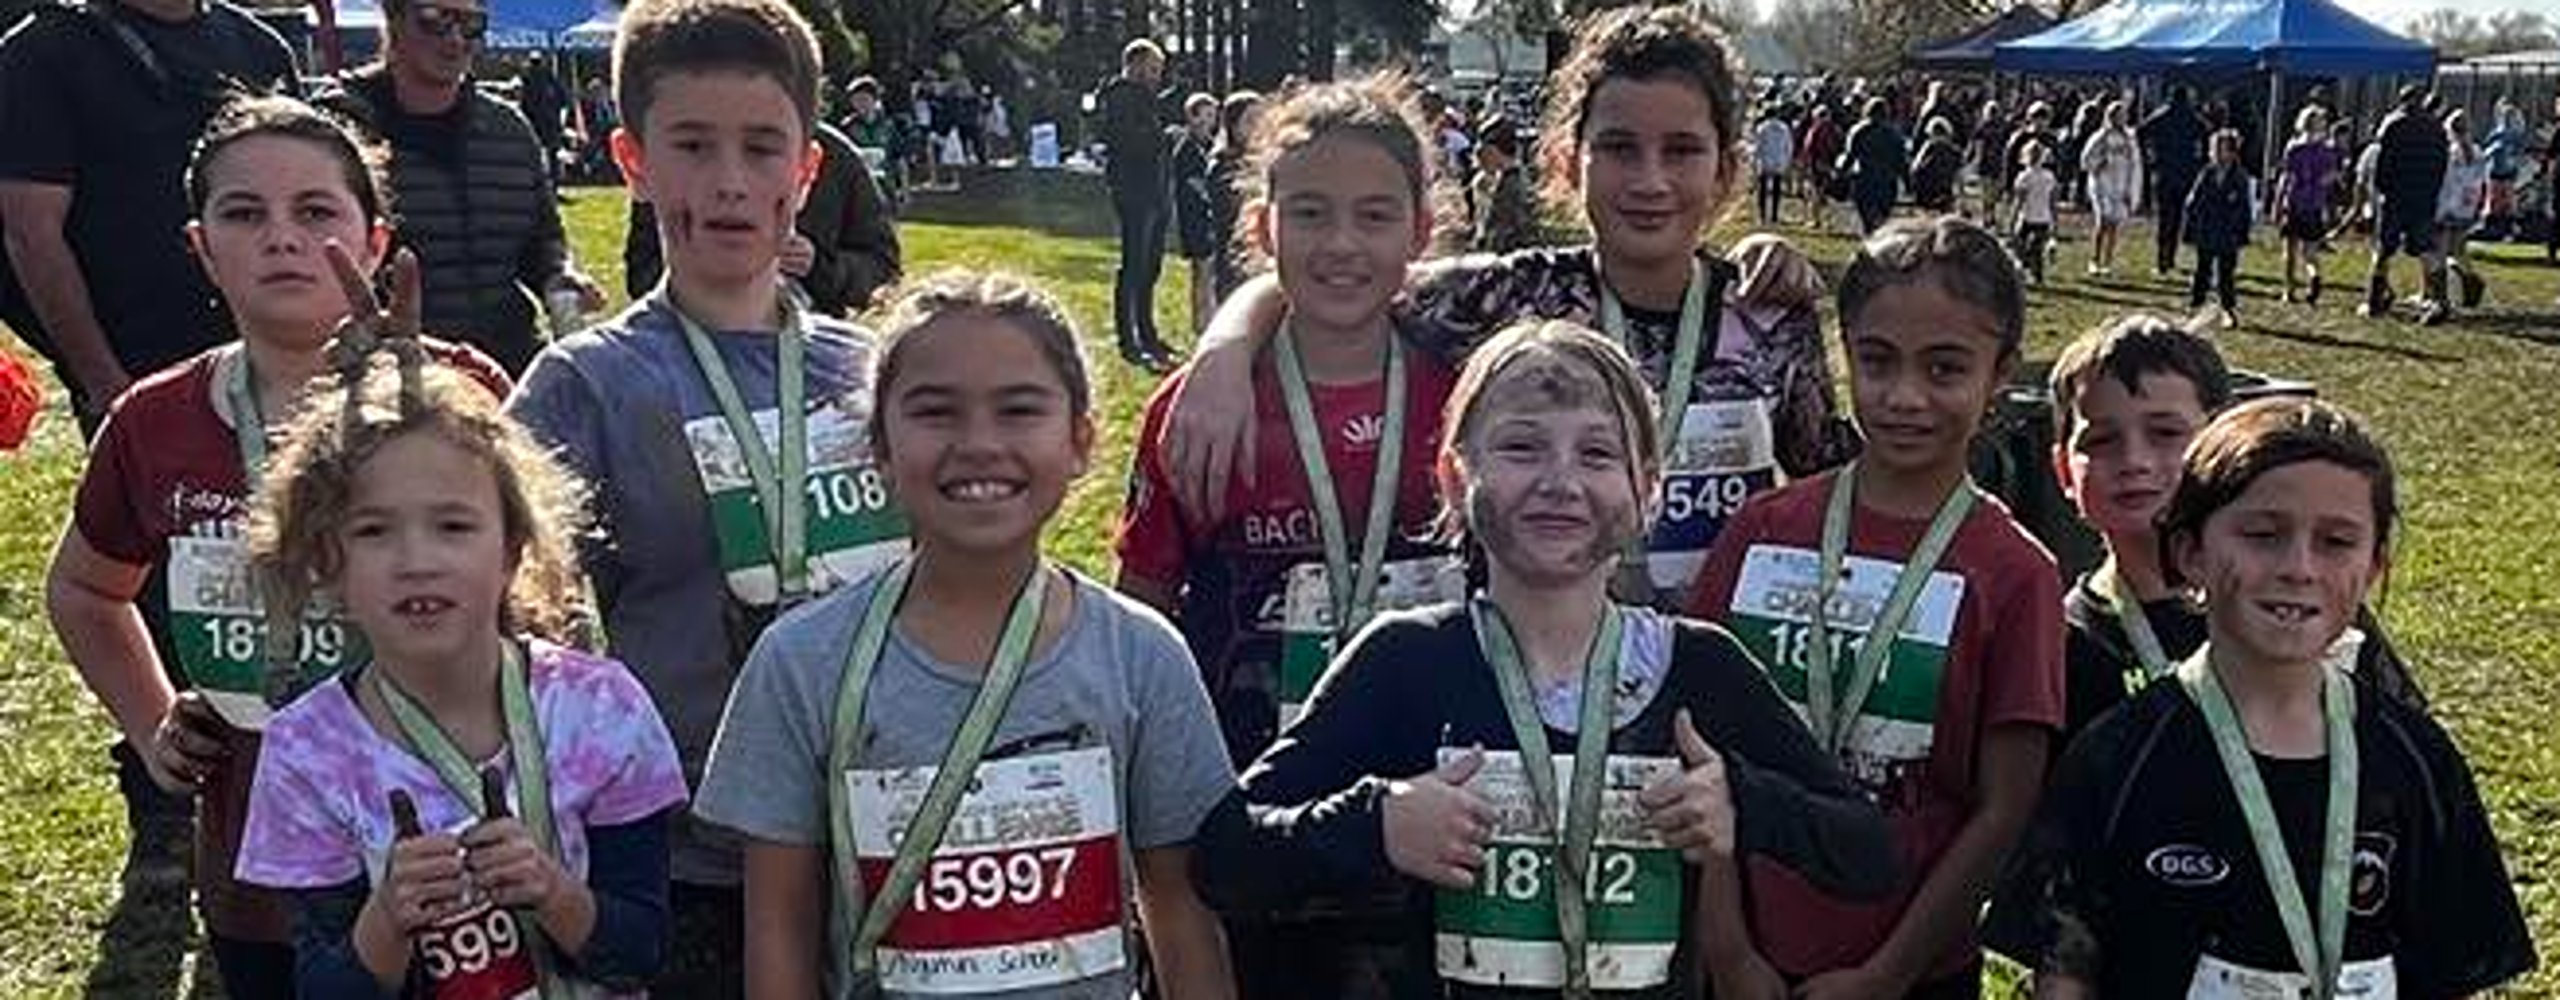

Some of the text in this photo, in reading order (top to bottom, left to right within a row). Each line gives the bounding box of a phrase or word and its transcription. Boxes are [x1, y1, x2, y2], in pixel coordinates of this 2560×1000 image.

[1655, 475, 1747, 521] 549
[204, 617, 344, 666] 1809
[914, 848, 1076, 911] 15997
[1483, 848, 1637, 903] 1812
[2161, 854, 2214, 874] DGS
[420, 909, 519, 978] 599
